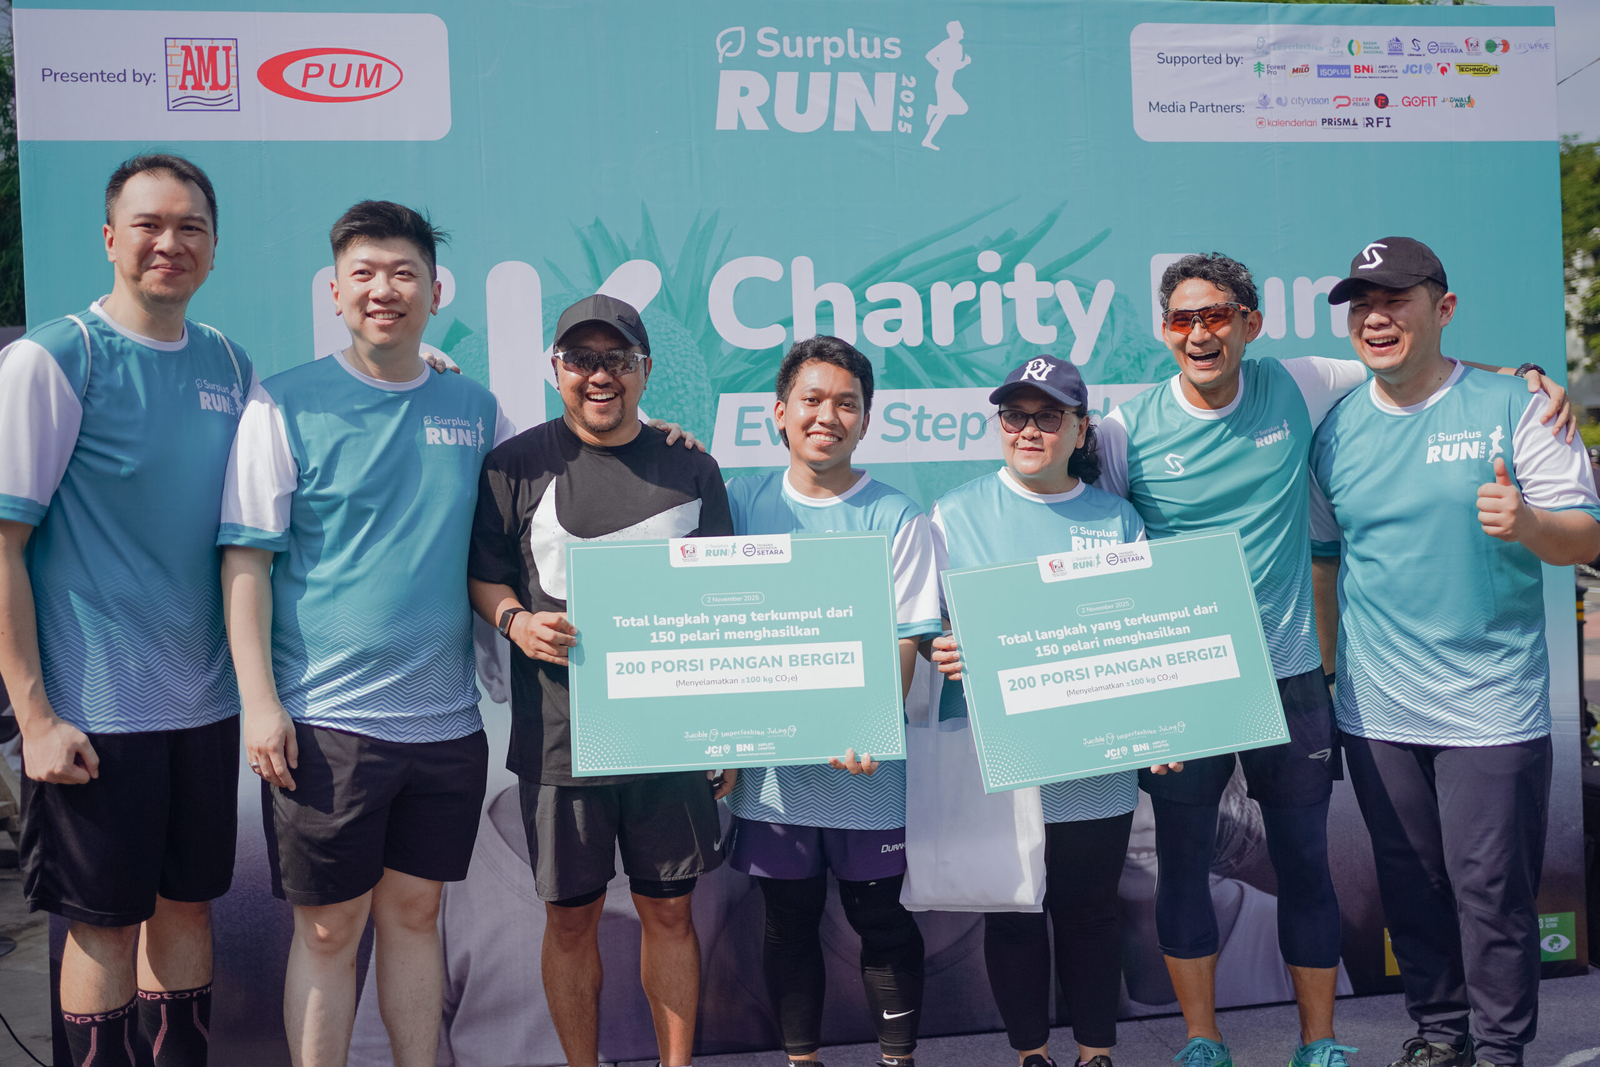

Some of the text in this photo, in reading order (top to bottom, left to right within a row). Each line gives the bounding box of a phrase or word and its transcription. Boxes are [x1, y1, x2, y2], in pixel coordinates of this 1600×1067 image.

[756, 27, 901, 65] Surplus
[179, 45, 232, 92] AMU
[1157, 52, 1244, 67] Supported by:
[41, 67, 156, 87] Presented by:
[302, 63, 383, 89] PUM
[1402, 64, 1422, 74] JCI
[715, 70, 897, 133] RUN
[898, 73, 917, 134] 2025
[1148, 101, 1245, 113] Media Partners:
[1402, 96, 1438, 107] GOFIT
[1267, 119, 1318, 127] kalenderlari
[708, 250, 1350, 366] Charity un
[203, 379, 230, 394] Surplus
[199, 391, 231, 415] RUN
[434, 415, 471, 427] Surplus
[881, 403, 987, 450] Step
[426, 427, 472, 447] RUN
[1255, 430, 1283, 448] RUN
[1438, 430, 1482, 442] Surplus
[1426, 441, 1480, 464] RUN
[1080, 526, 1118, 538] Surplus
[705, 548, 728, 557] RUN
[1119, 555, 1145, 563] SETARA
[1072, 560, 1093, 570] RUN
[712, 595, 742, 603] November
[1086, 603, 1114, 612] November
[613, 605, 853, 627] Total langkah yang terkumpul dari
[997, 602, 1218, 646] Total langkah yang terkumpul dari
[650, 625, 820, 644] 150 pelari menghasilkan
[1035, 625, 1191, 657] 150 pelari menghasilkan
[615, 651, 855, 675] 200 PORSI PANGAN BERGIZI
[1007, 645, 1228, 691] 200 PORSI PANGAN BERGIZI
[675, 677, 739, 688] (Menyelamatkan
[763, 675, 773, 684] kg
[1066, 681, 1125, 697] (Menyelamatkan
[1146, 676, 1156, 685] kg
[705, 745, 722, 755] JCI
[1104, 748, 1120, 758] JCI
[138, 985, 213, 1001] aptoni
